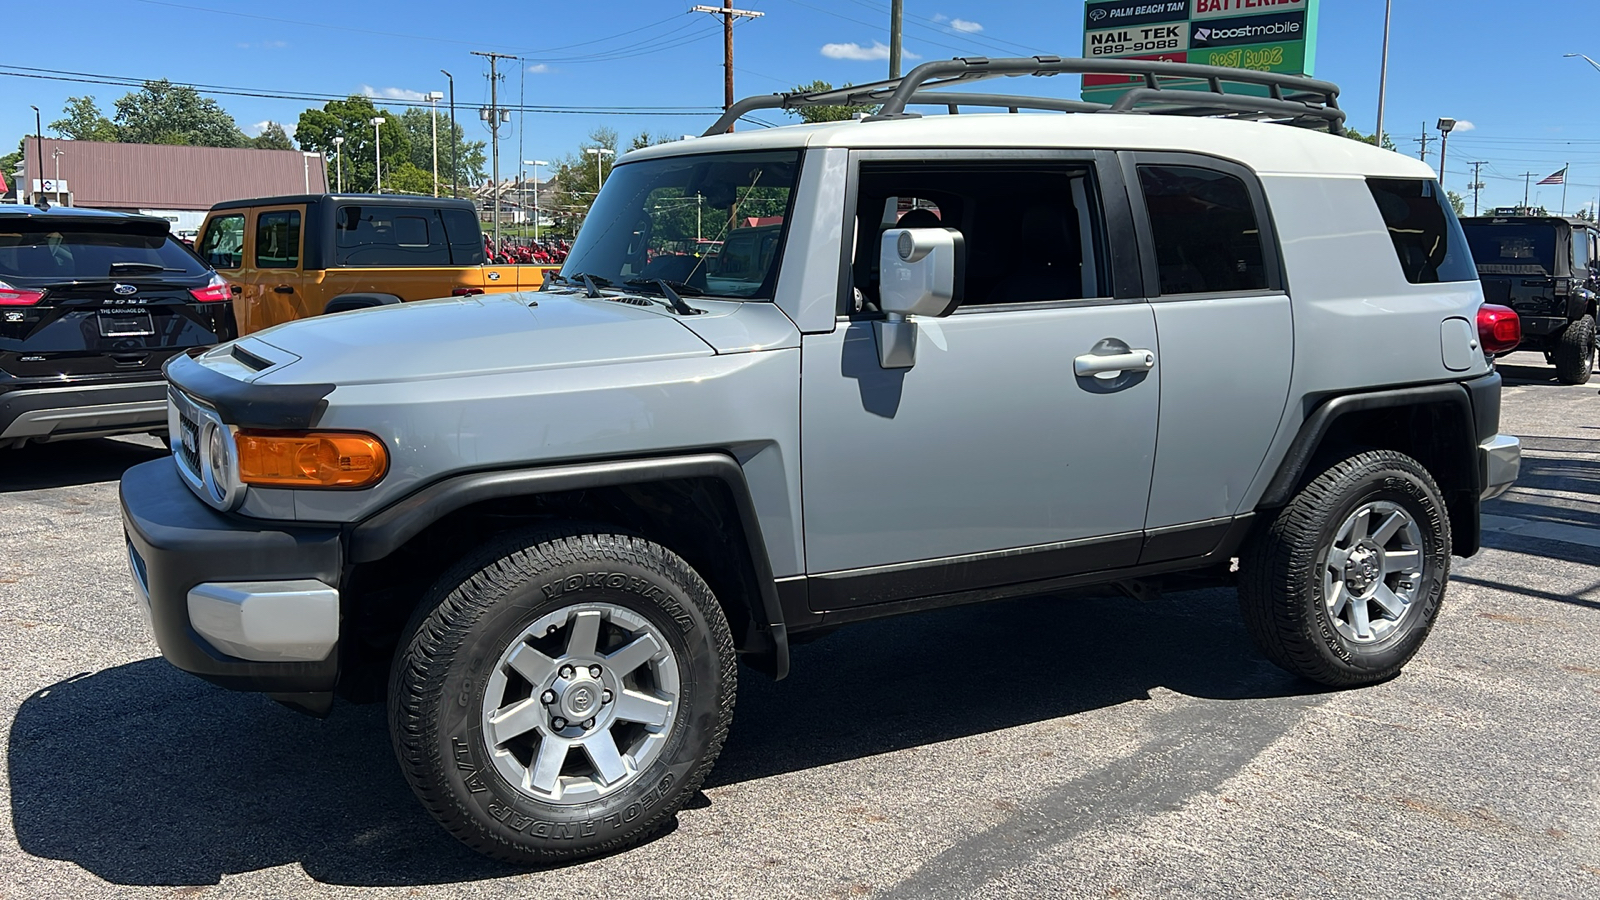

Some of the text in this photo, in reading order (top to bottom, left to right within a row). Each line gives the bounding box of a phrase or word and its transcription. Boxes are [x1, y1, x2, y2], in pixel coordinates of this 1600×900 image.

[1109, 1, 1185, 18] PALM BEACH TAN
[1091, 26, 1180, 45] NAIL TEK
[1211, 21, 1300, 39] boostmobile
[1092, 39, 1178, 55] 689-9088
[1243, 46, 1284, 67] BUDZ
[541, 572, 696, 634] YOKOHAMA
[488, 771, 676, 841] GEOLANDAR
